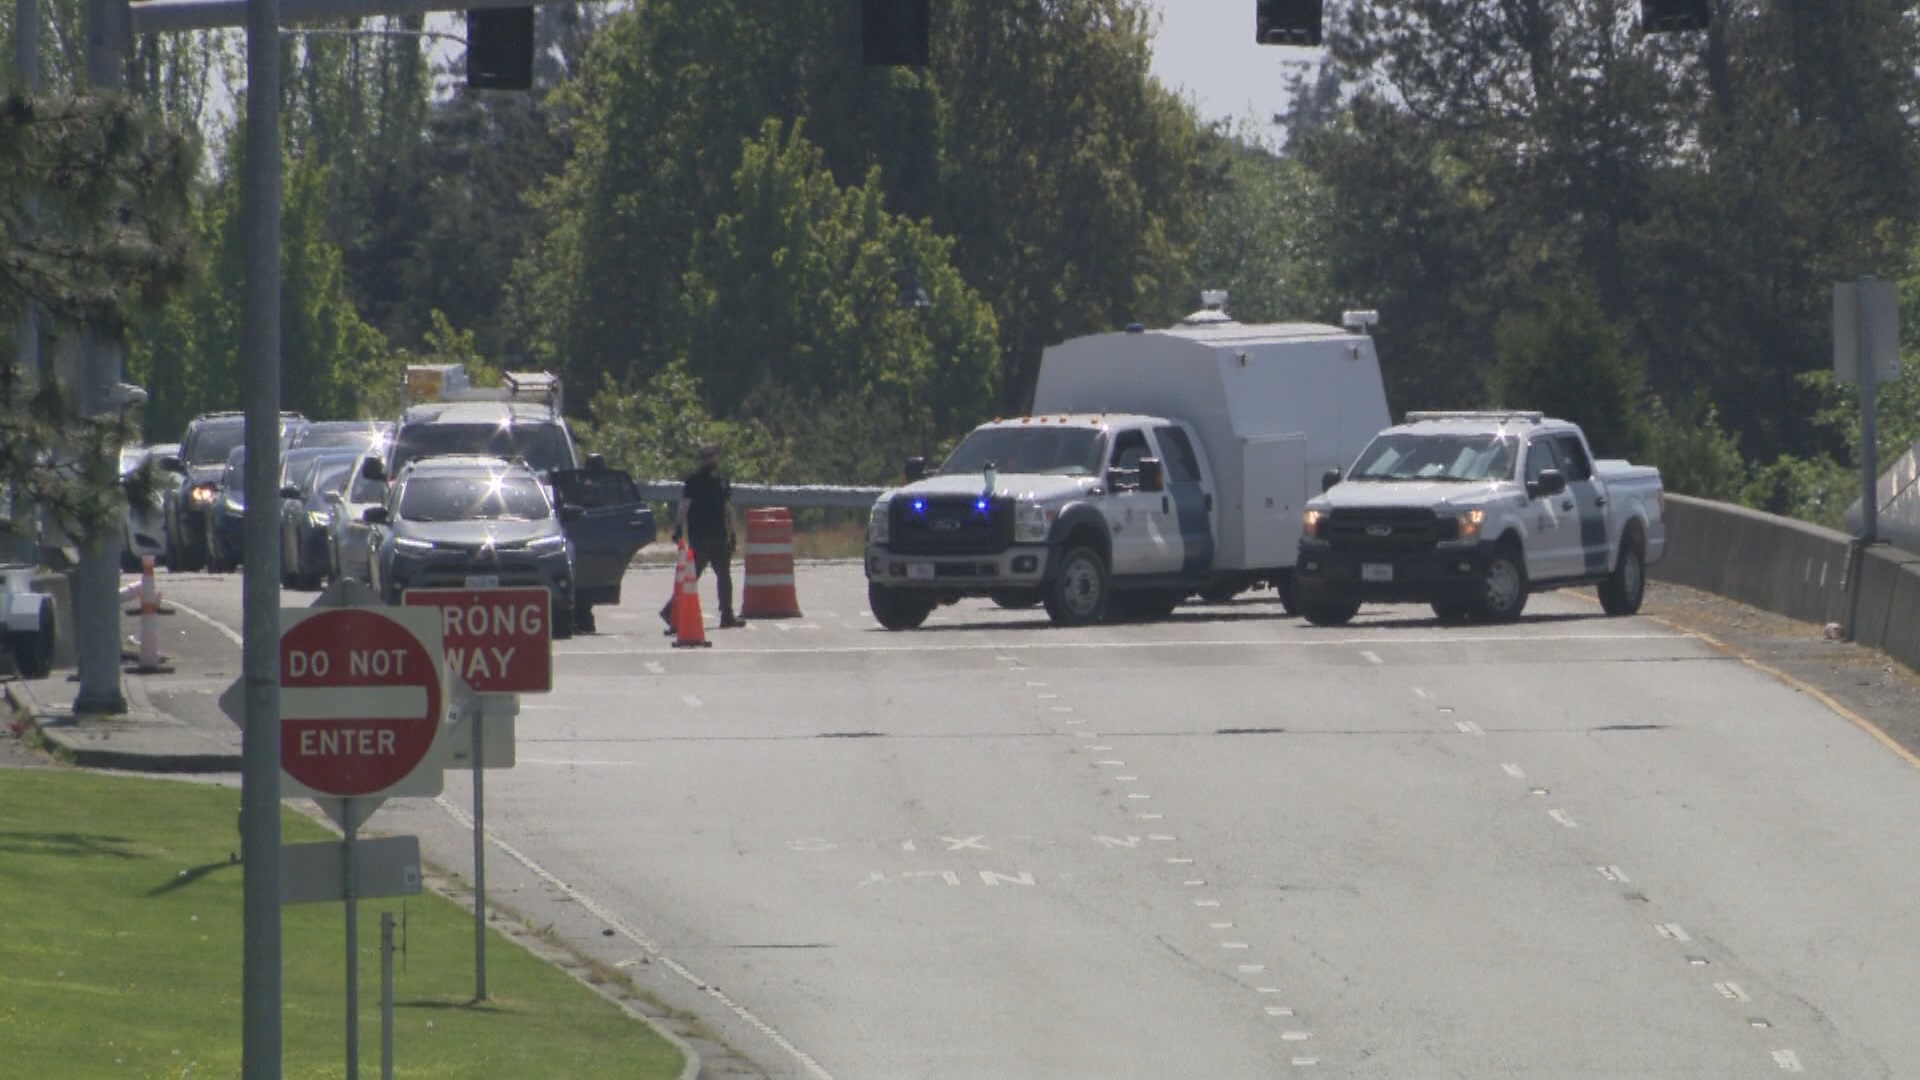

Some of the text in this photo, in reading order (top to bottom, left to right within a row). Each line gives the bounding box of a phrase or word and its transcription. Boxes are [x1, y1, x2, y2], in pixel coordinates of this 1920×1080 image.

[443, 604, 542, 636] RONG
[289, 649, 408, 678] DO NOT
[300, 729, 396, 757] ENTER
